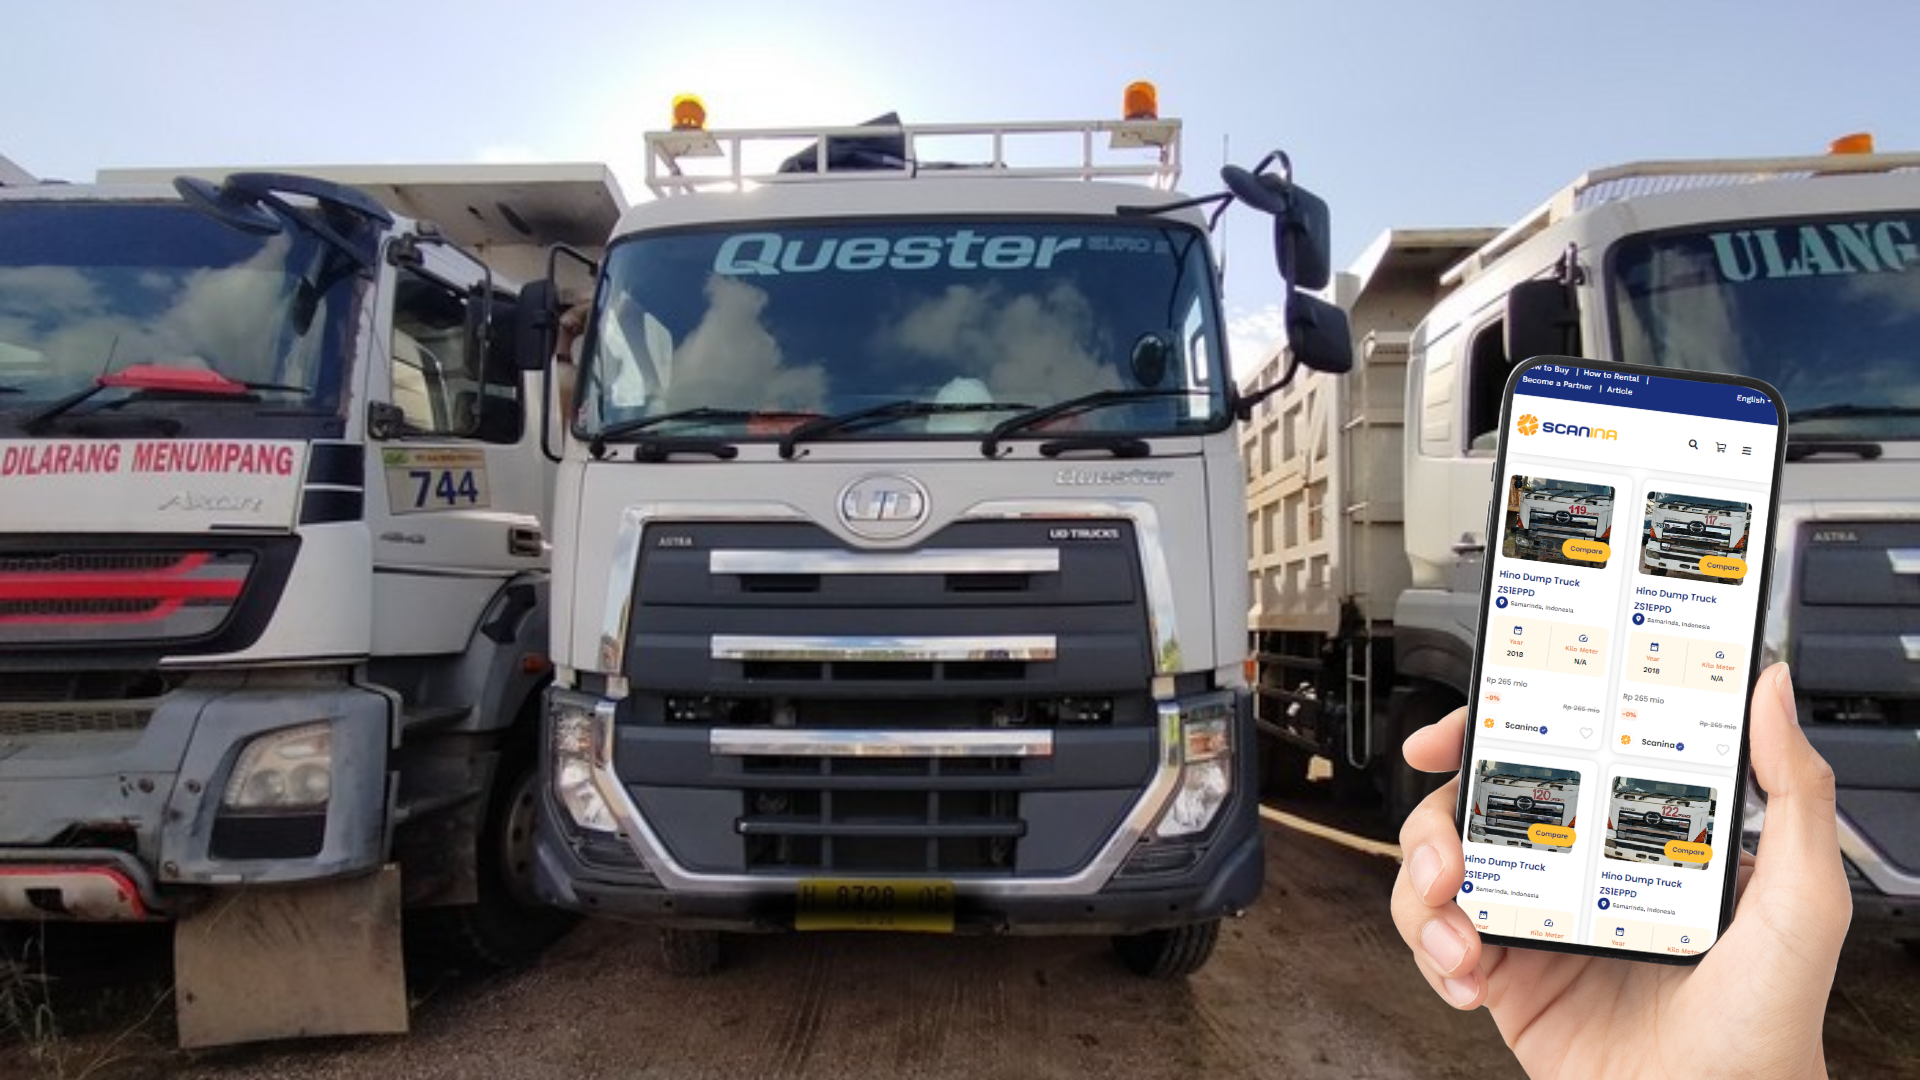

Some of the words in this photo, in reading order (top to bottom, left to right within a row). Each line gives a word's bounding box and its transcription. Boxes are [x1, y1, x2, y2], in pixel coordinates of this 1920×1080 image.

[713, 229, 1082, 275] Quester
[1709, 220, 1920, 282] ULANG
[1554, 365, 1570, 376] Buy
[1583, 369, 1602, 378] How
[1603, 371, 1612, 379] to
[1614, 372, 1640, 383] Rental
[1522, 375, 1554, 386] Become
[1563, 380, 1593, 391] Partner
[1606, 386, 1633, 396] Article
[1737, 394, 1766, 404] English
[2, 446, 121, 475] DILARANG
[132, 442, 294, 475] MENUMPANG
[409, 470, 478, 508] 744
[1569, 505, 1587, 515] 119
[1071, 529, 1119, 538] TRUCKS
[1570, 545, 1603, 555] Compare
[1707, 562, 1740, 572] Compare
[1500, 570, 1521, 581] Hino
[1523, 573, 1552, 585] Dump
[1554, 576, 1580, 587] Truck
[1636, 587, 1658, 598] Hino
[1660, 590, 1688, 602] Dump
[1690, 593, 1716, 604] Truck
[1509, 638, 1524, 646] Year
[1507, 650, 1524, 658] 2018
[1646, 654, 1660, 662] Year
[1574, 658, 1587, 666] N/A
[1644, 666, 1660, 674] 2018
[1486, 677, 1496, 686] Rp
[1498, 678, 1512, 686] 265
[1513, 680, 1528, 688] mio
[1710, 674, 1724, 682] N/A
[1623, 694, 1632, 703] Rp
[1634, 694, 1648, 702] 265
[1650, 696, 1664, 704] mio
[1505, 722, 1538, 733] Scanina
[1642, 738, 1675, 750] Scanina
[1533, 789, 1551, 800] 120
[1662, 806, 1680, 817] 122
[1535, 830, 1568, 840] Compare
[1672, 846, 1705, 856] Compare
[1465, 855, 1486, 866] Hino
[1488, 858, 1517, 870] Dump
[1519, 861, 1545, 872] Truck
[1601, 872, 1623, 882] Hino
[1625, 874, 1654, 886] Dump
[1656, 878, 1682, 888] Truck
[1611, 939, 1625, 947] Year
[1667, 946, 1679, 954] Kilo
